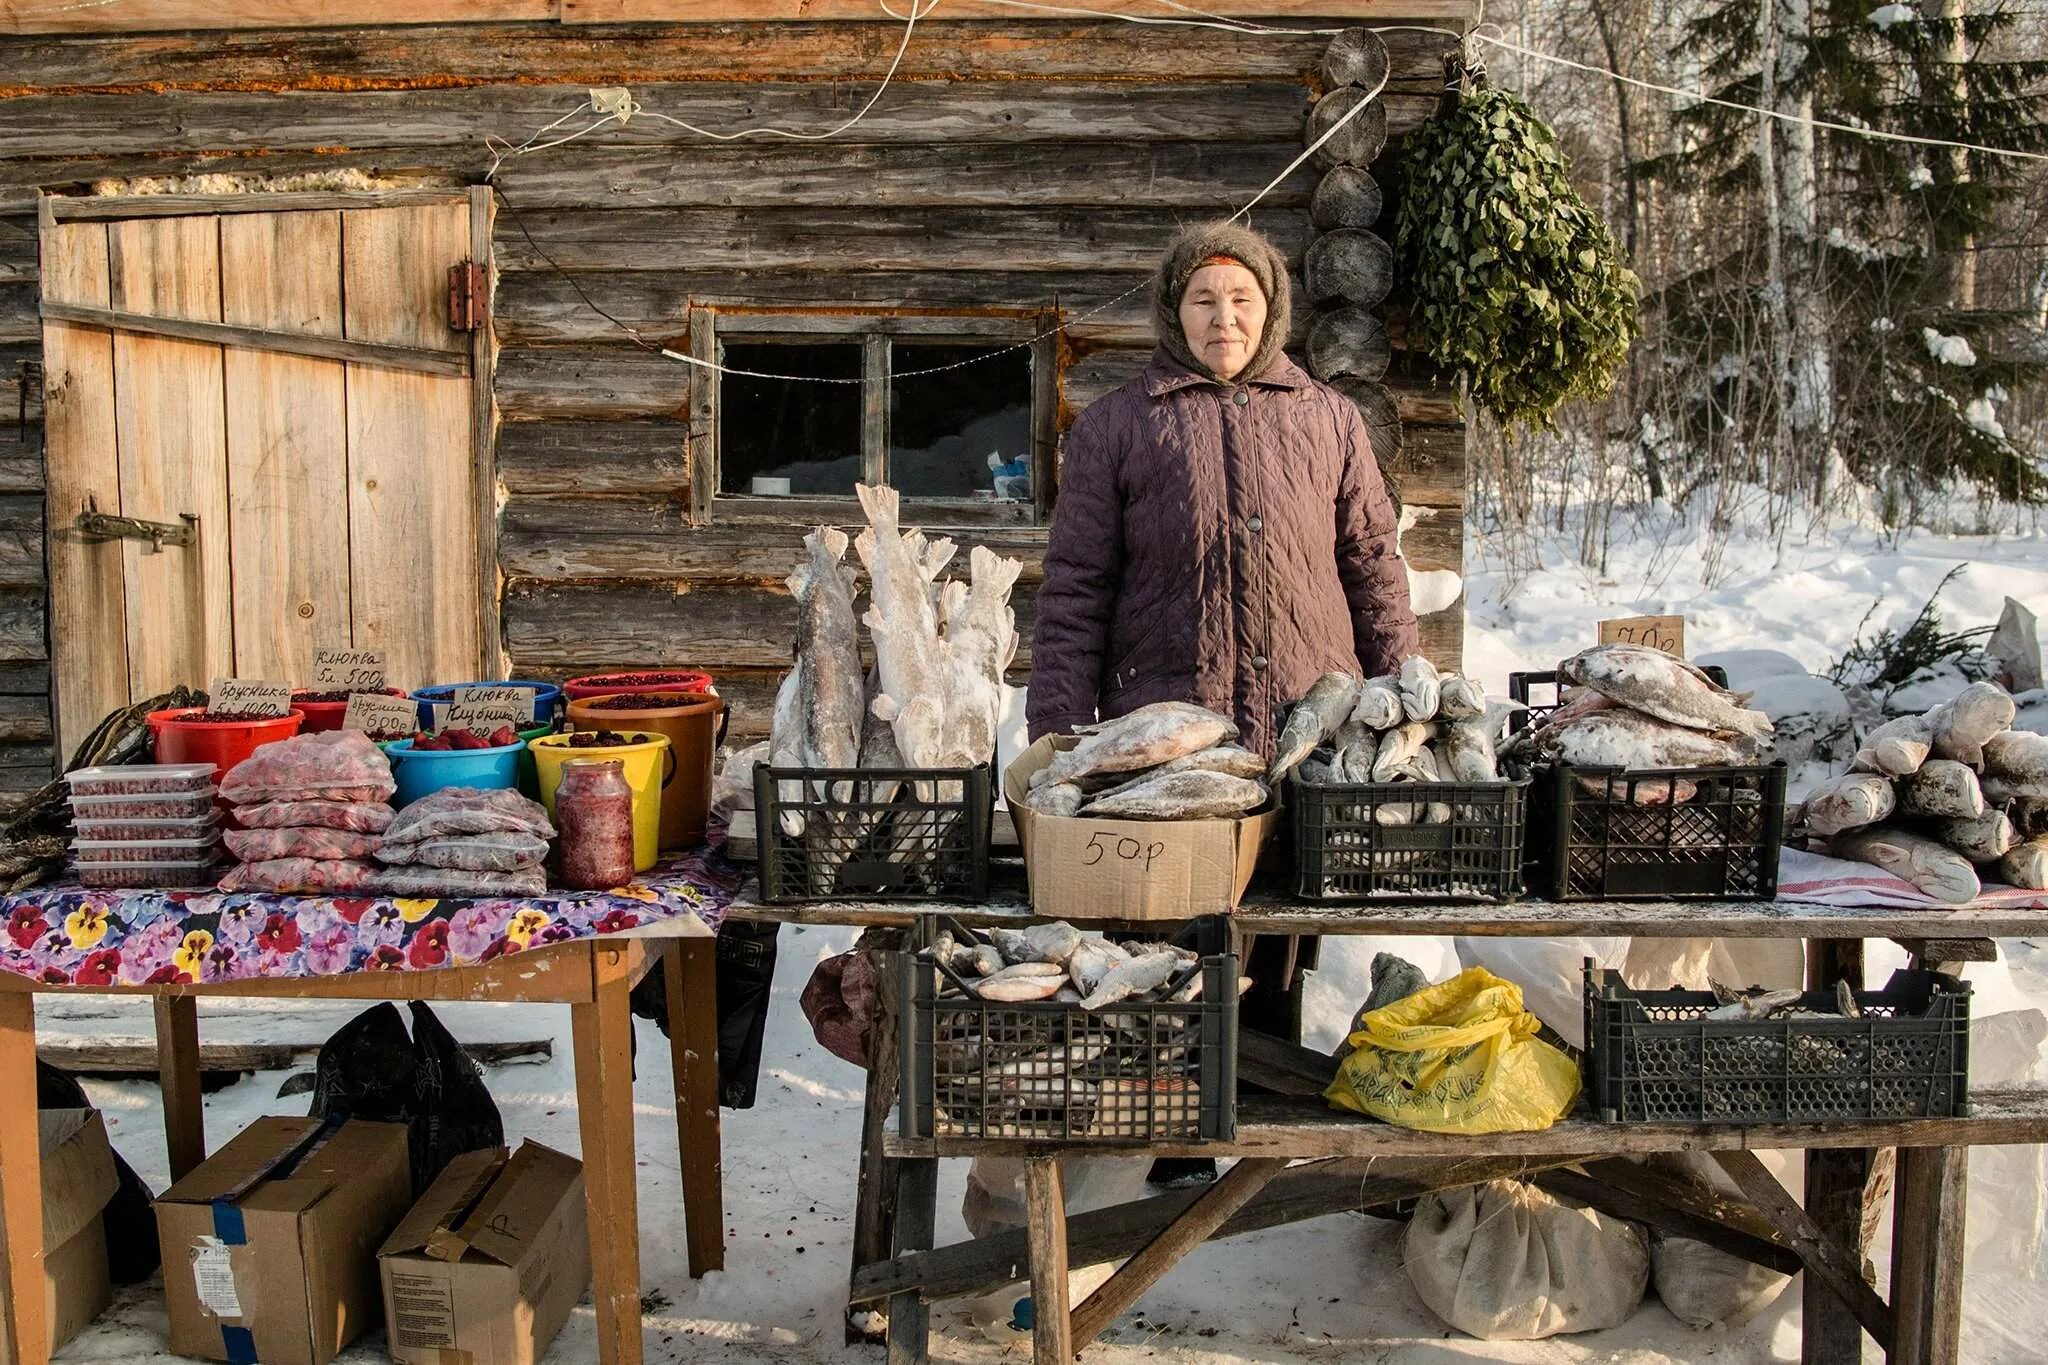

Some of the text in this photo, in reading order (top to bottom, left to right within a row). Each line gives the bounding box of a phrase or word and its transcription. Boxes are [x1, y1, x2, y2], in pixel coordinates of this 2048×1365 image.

[315, 651, 381, 666] Клюква
[463, 688, 522, 703] Клюква
[445, 704, 514, 725] Клубника
